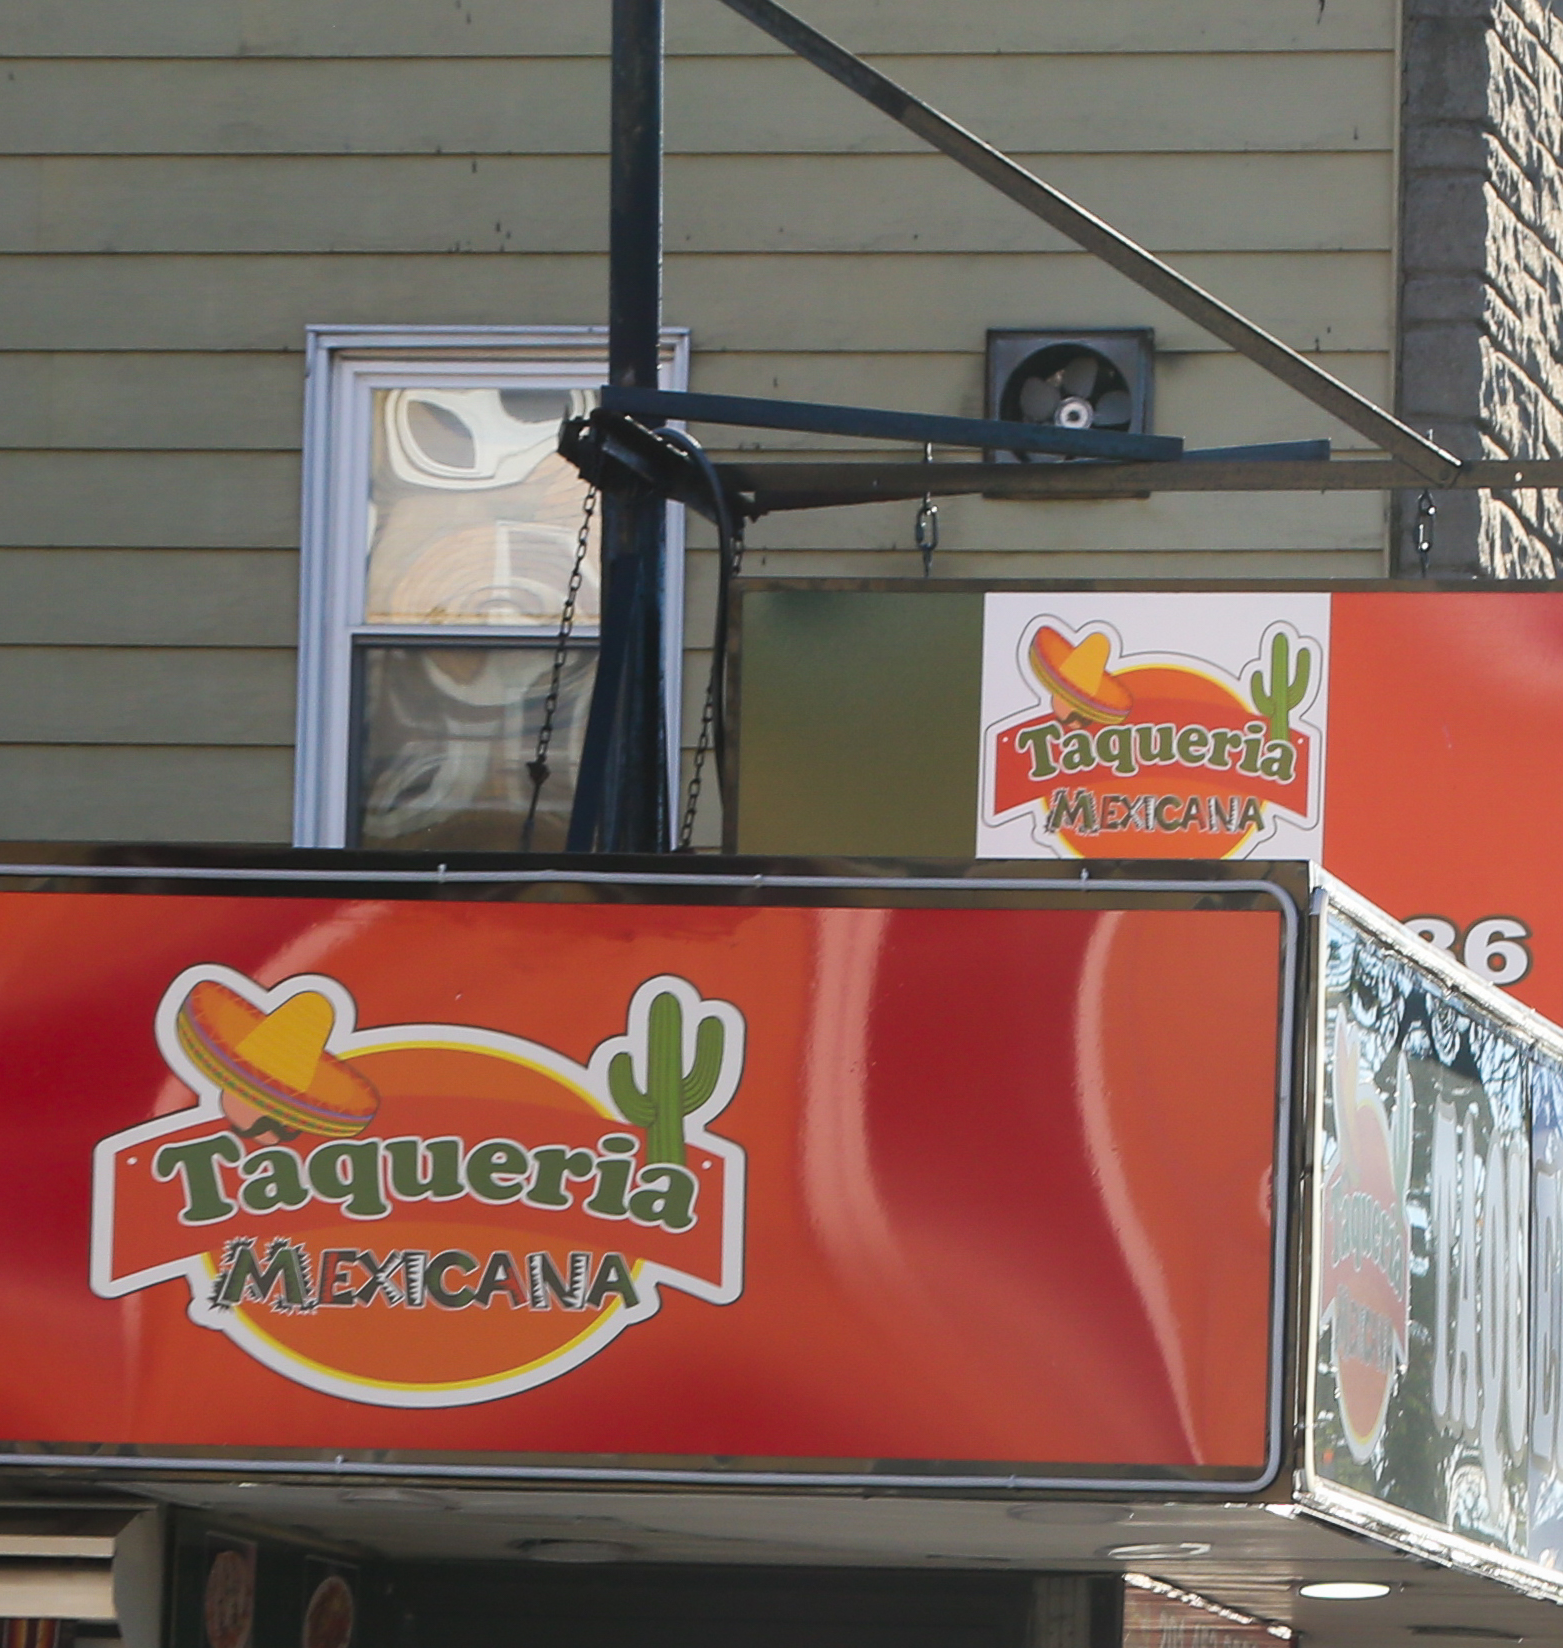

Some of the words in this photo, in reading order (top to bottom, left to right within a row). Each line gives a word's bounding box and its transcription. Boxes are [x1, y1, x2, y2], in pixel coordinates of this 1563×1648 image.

[1017, 722, 1296, 785] Taqueria
[1043, 788, 1266, 835] MEXICANA
[153, 1132, 699, 1233] Taqueria
[208, 1236, 641, 1315] MEXICANA
